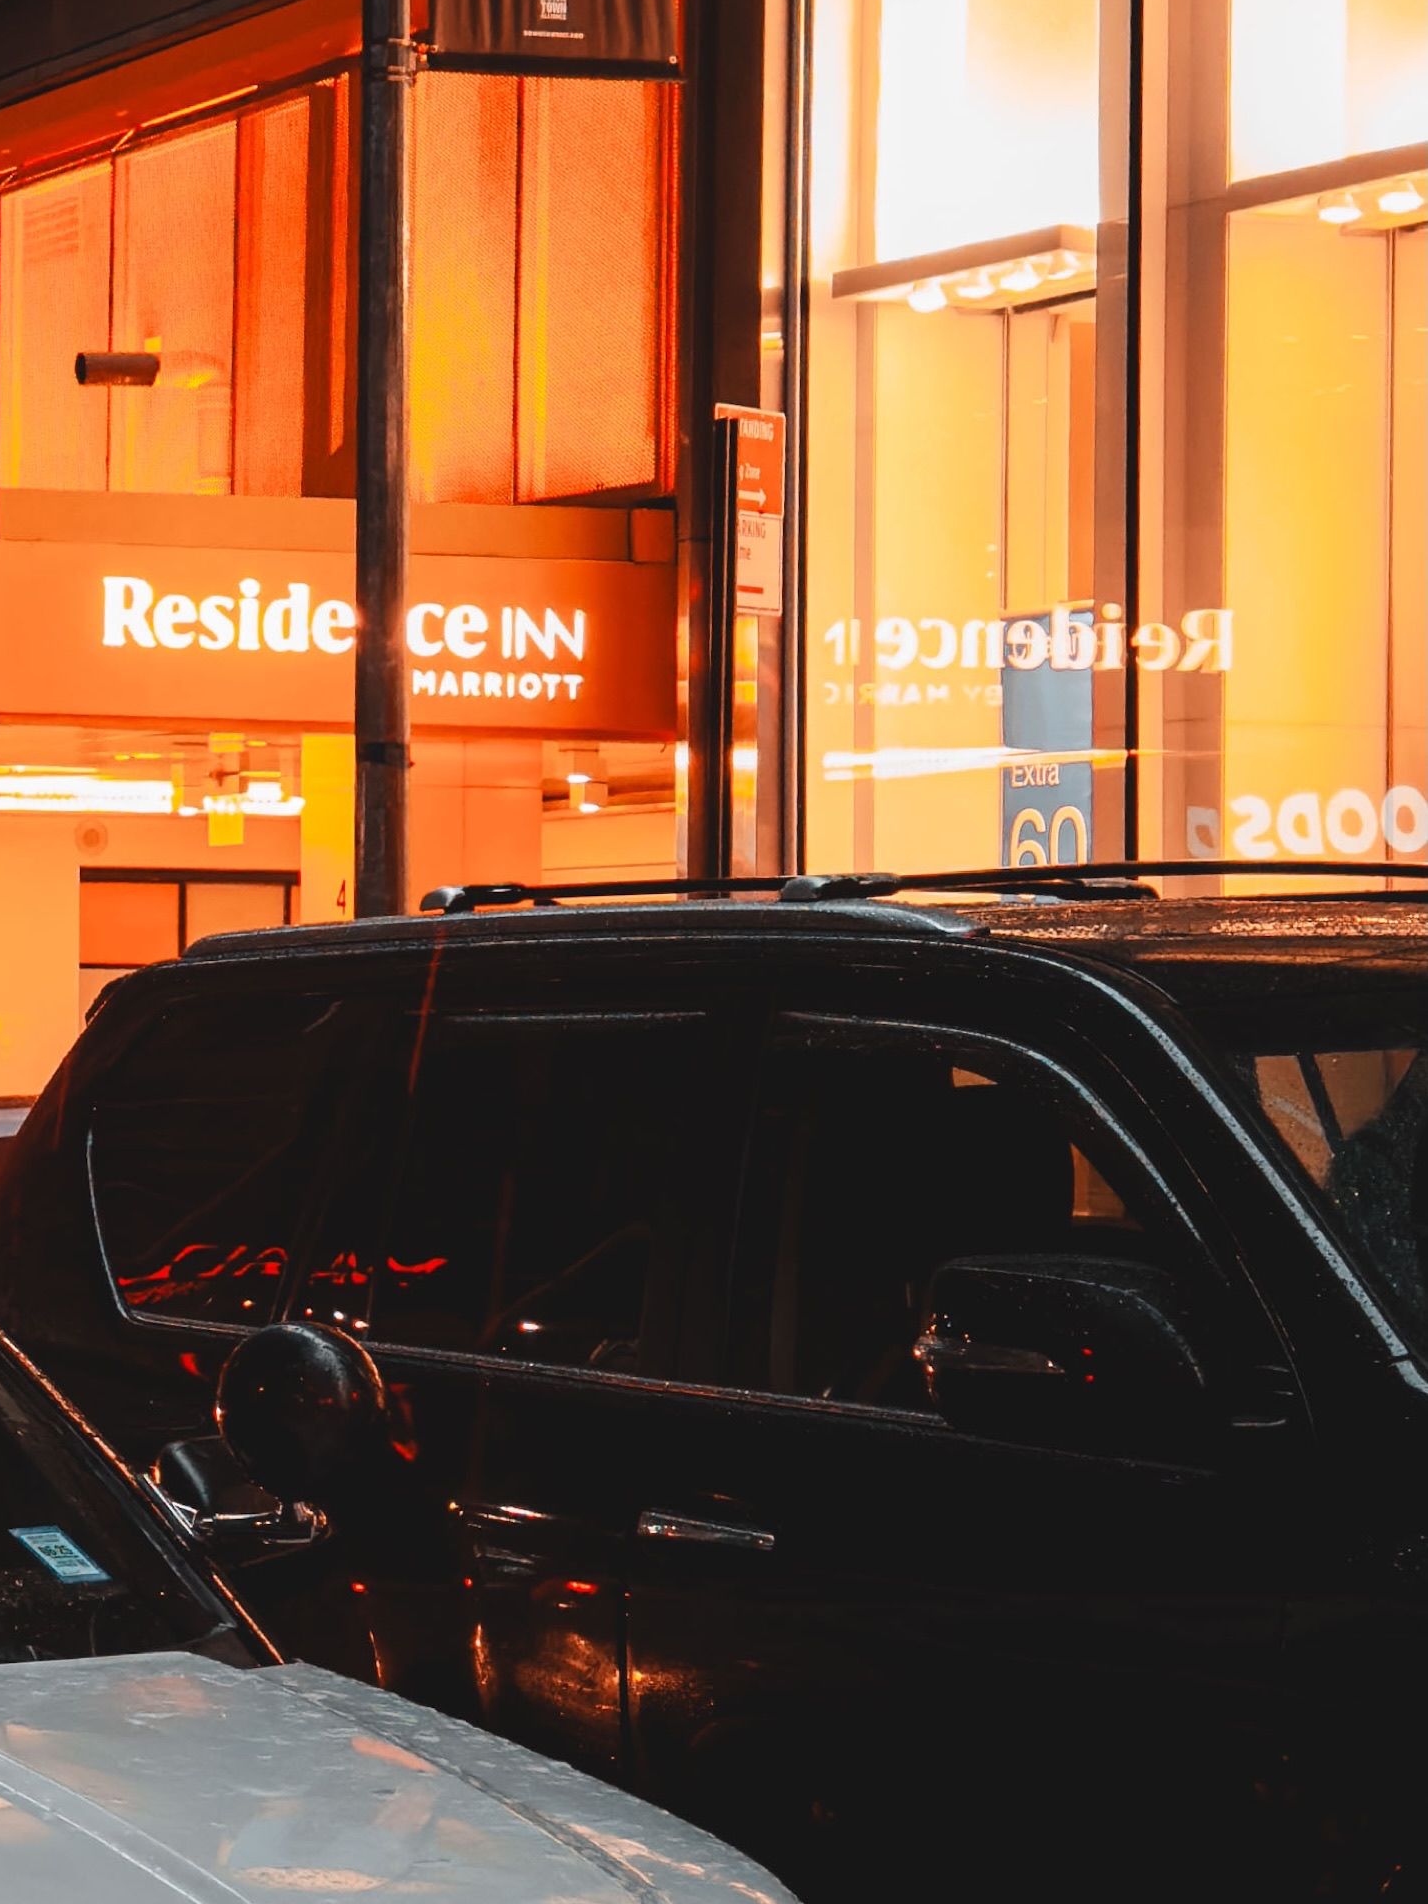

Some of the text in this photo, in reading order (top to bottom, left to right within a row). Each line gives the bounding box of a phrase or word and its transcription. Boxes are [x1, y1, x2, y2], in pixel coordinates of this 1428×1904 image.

[739, 418, 775, 442] TANDING
[101, 576, 586, 661] Residece INN
[412, 669, 585, 702] MARRIOTT
[1011, 763, 1061, 787] Extra
[1010, 805, 1088, 867] 60
